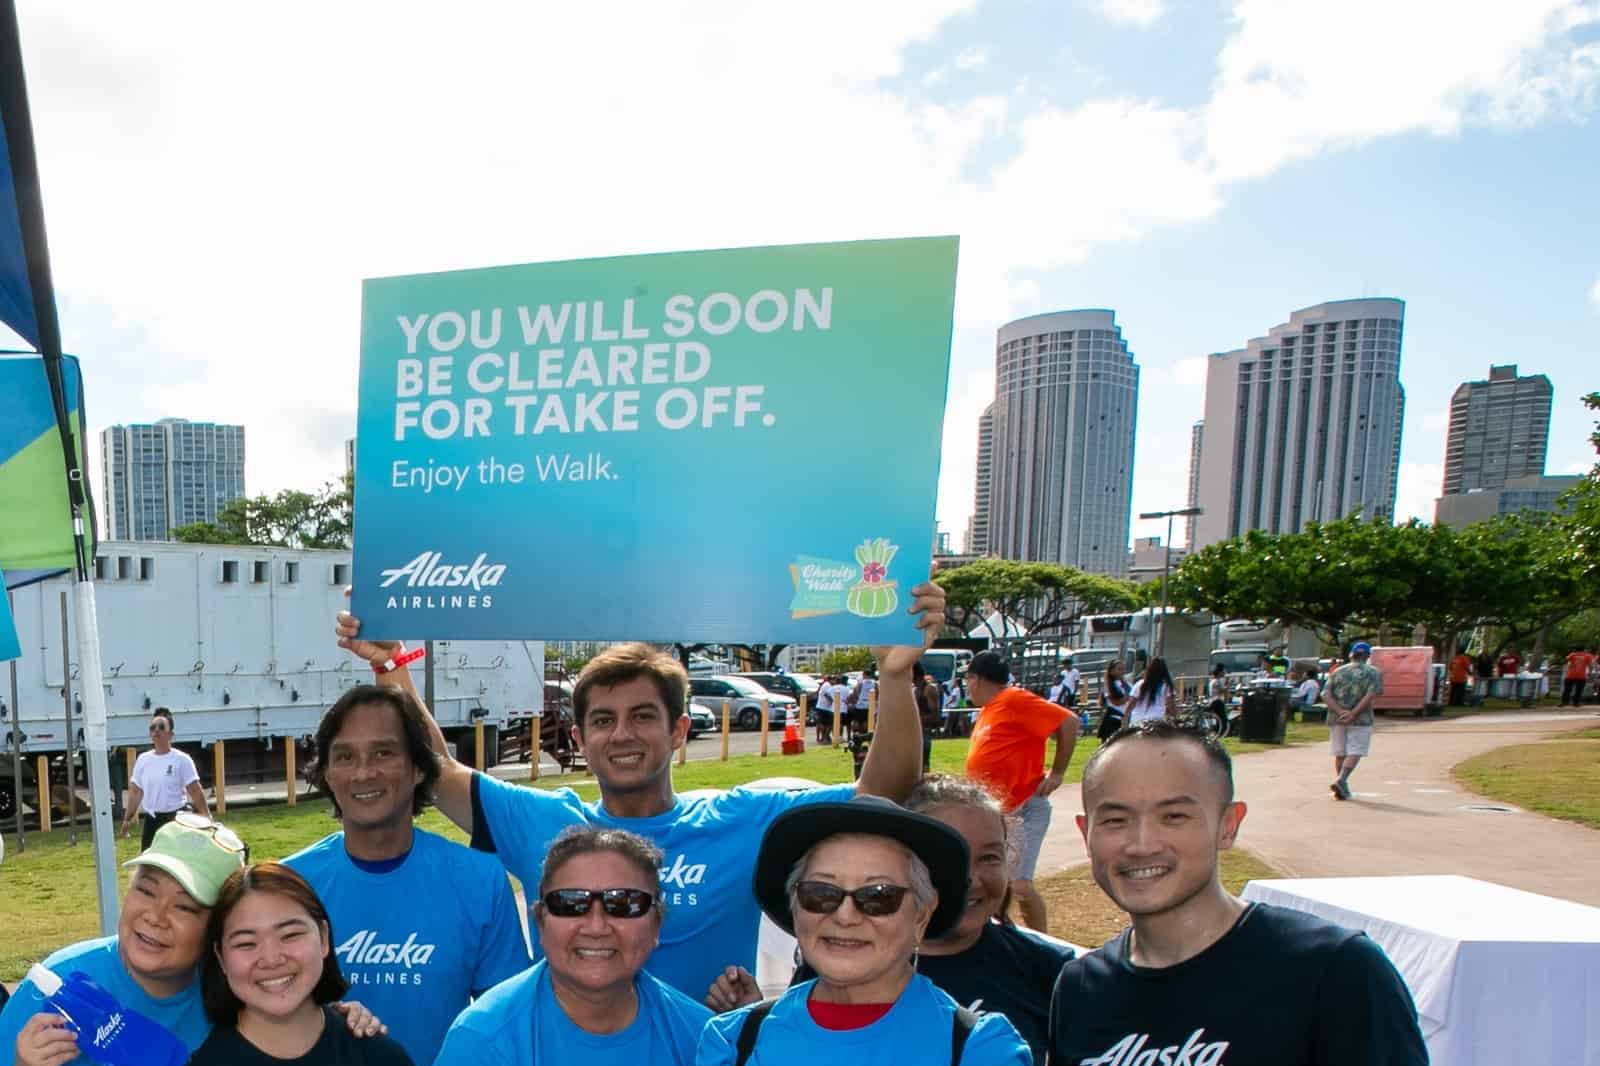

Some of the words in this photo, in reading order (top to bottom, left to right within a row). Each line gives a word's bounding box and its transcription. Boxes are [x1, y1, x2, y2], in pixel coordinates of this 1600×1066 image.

[398, 308, 502, 354] YOU
[518, 299, 649, 345] WILL
[663, 288, 833, 336] SOON
[396, 356, 453, 399] BE
[467, 342, 710, 393] CLEARED
[393, 398, 493, 442] FOR
[504, 391, 640, 435] TAKE
[655, 385, 775, 430] OFF.
[391, 458, 470, 494] Enjoy
[477, 456, 525, 484] the
[535, 453, 618, 481] Walk.
[380, 550, 507, 592] Alaska
[386, 595, 492, 609] AIRLINES
[334, 929, 436, 969] Alaska
[342, 971, 423, 985] RLINES
